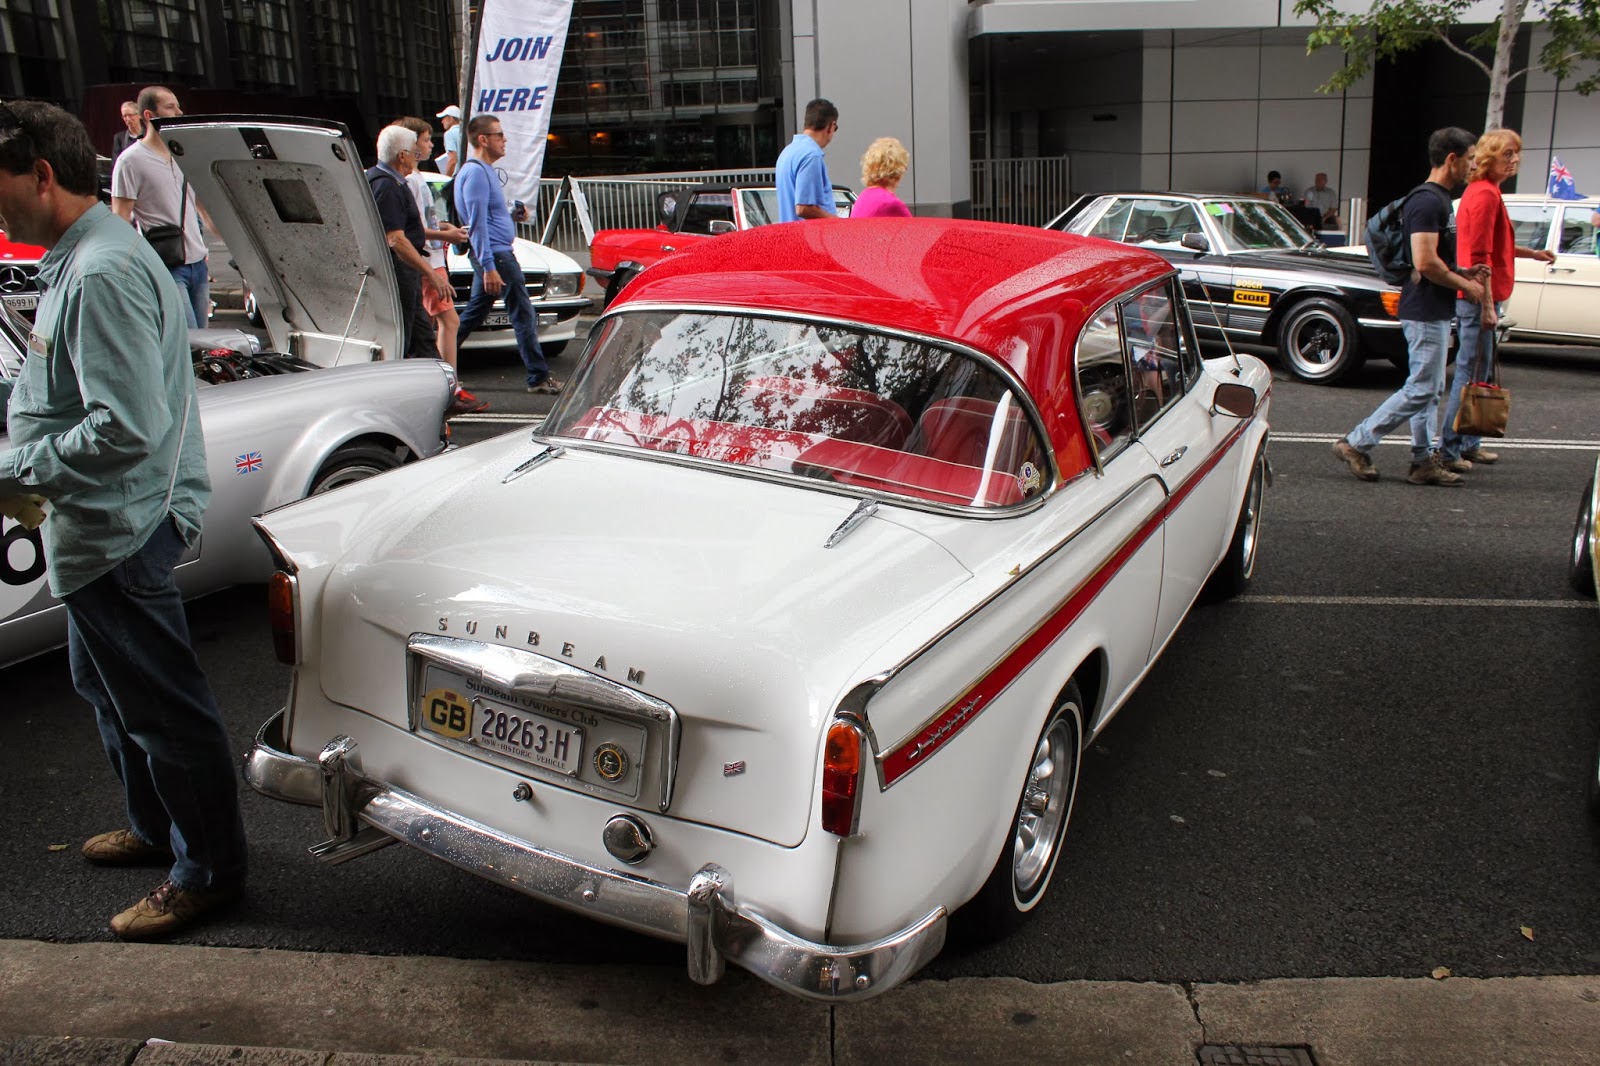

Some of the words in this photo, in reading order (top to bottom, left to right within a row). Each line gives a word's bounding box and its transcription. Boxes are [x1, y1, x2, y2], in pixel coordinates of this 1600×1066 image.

[486, 36, 553, 62] JOIN
[477, 85, 548, 113] HERE
[1236, 279, 1262, 289] BOSCH
[438, 617, 646, 685] SUNBEAM
[430, 698, 466, 732] GB
[465, 677, 518, 704] Sunbeam
[571, 710, 599, 728] Club
[500, 743, 532, 759] HISTORIC
[536, 754, 566, 770] VEHICLE
